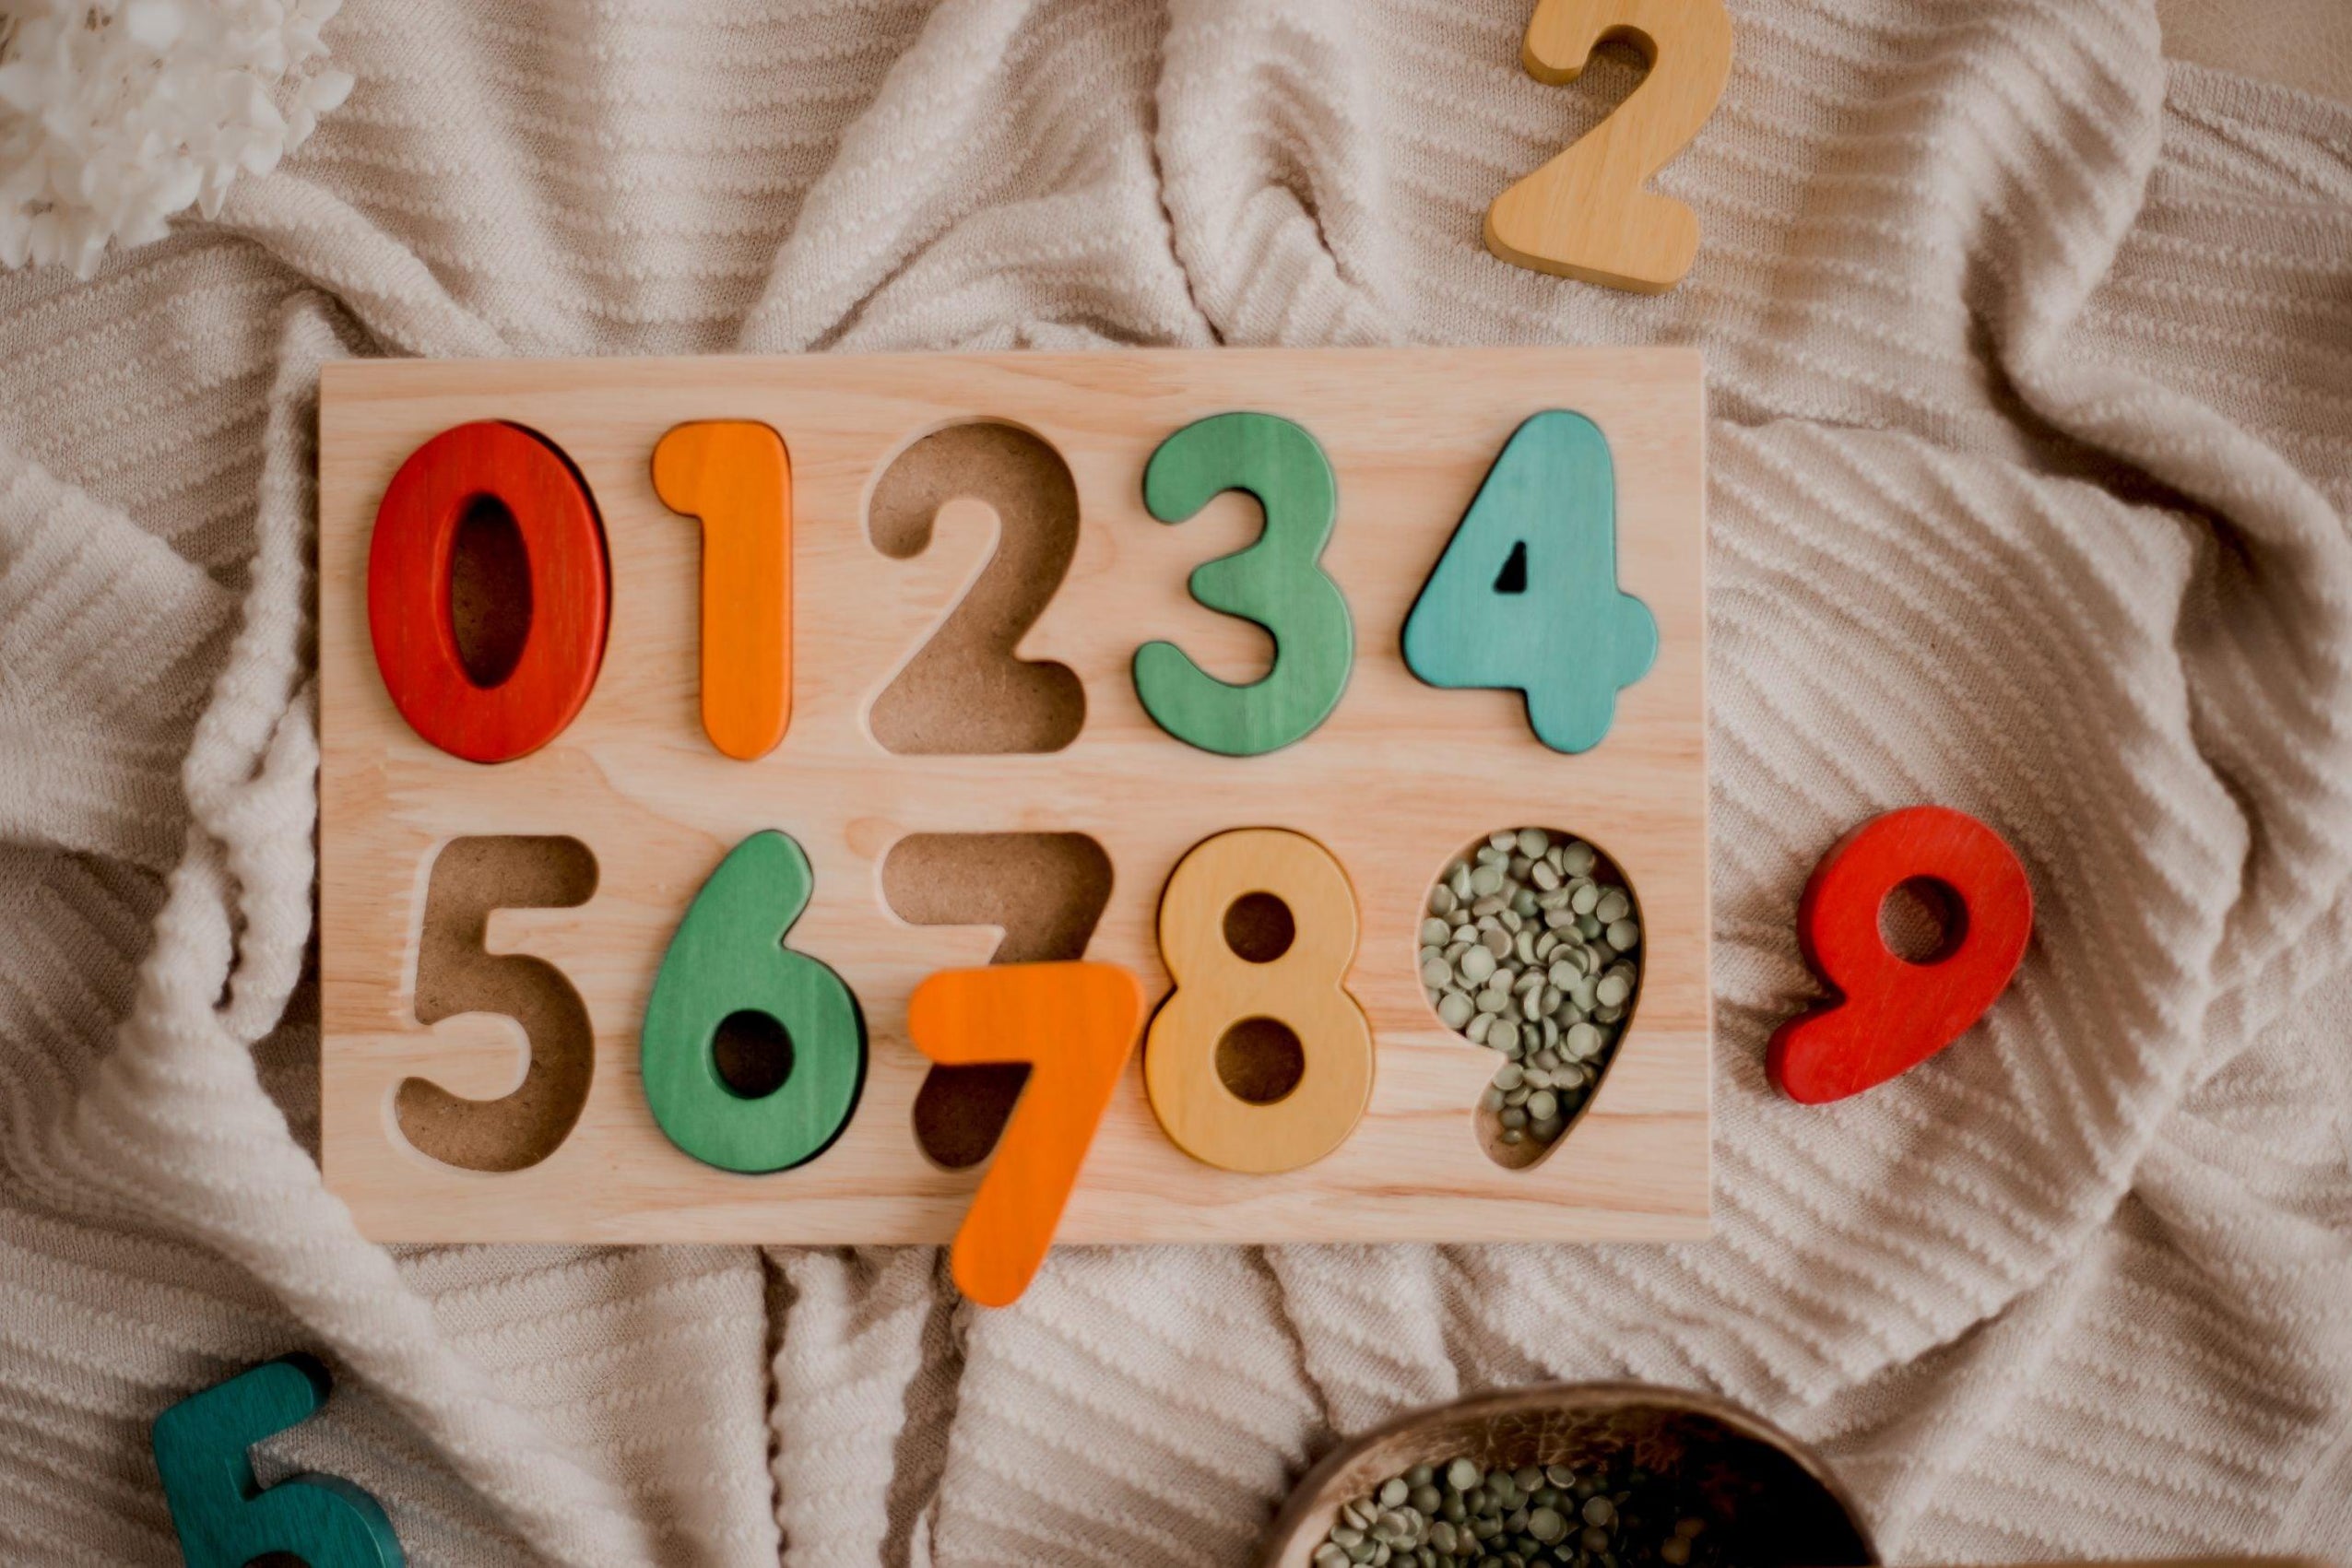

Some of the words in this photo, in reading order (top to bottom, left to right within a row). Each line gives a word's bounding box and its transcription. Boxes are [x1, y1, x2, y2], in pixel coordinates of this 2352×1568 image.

[1483, 0, 1733, 295] 2
[368, 420, 611, 763] 0
[652, 420, 792, 760] 1
[869, 417, 1086, 755] 2
[1132, 411, 1354, 757] 3
[1401, 409, 1659, 754] 4
[391, 834, 600, 1173] 5
[641, 829, 868, 1174] 6
[1144, 827, 1375, 1173] 8
[1418, 827, 1646, 1171] 9
[1766, 806, 2035, 1105] 9
[908, 961, 1145, 1307] 7
